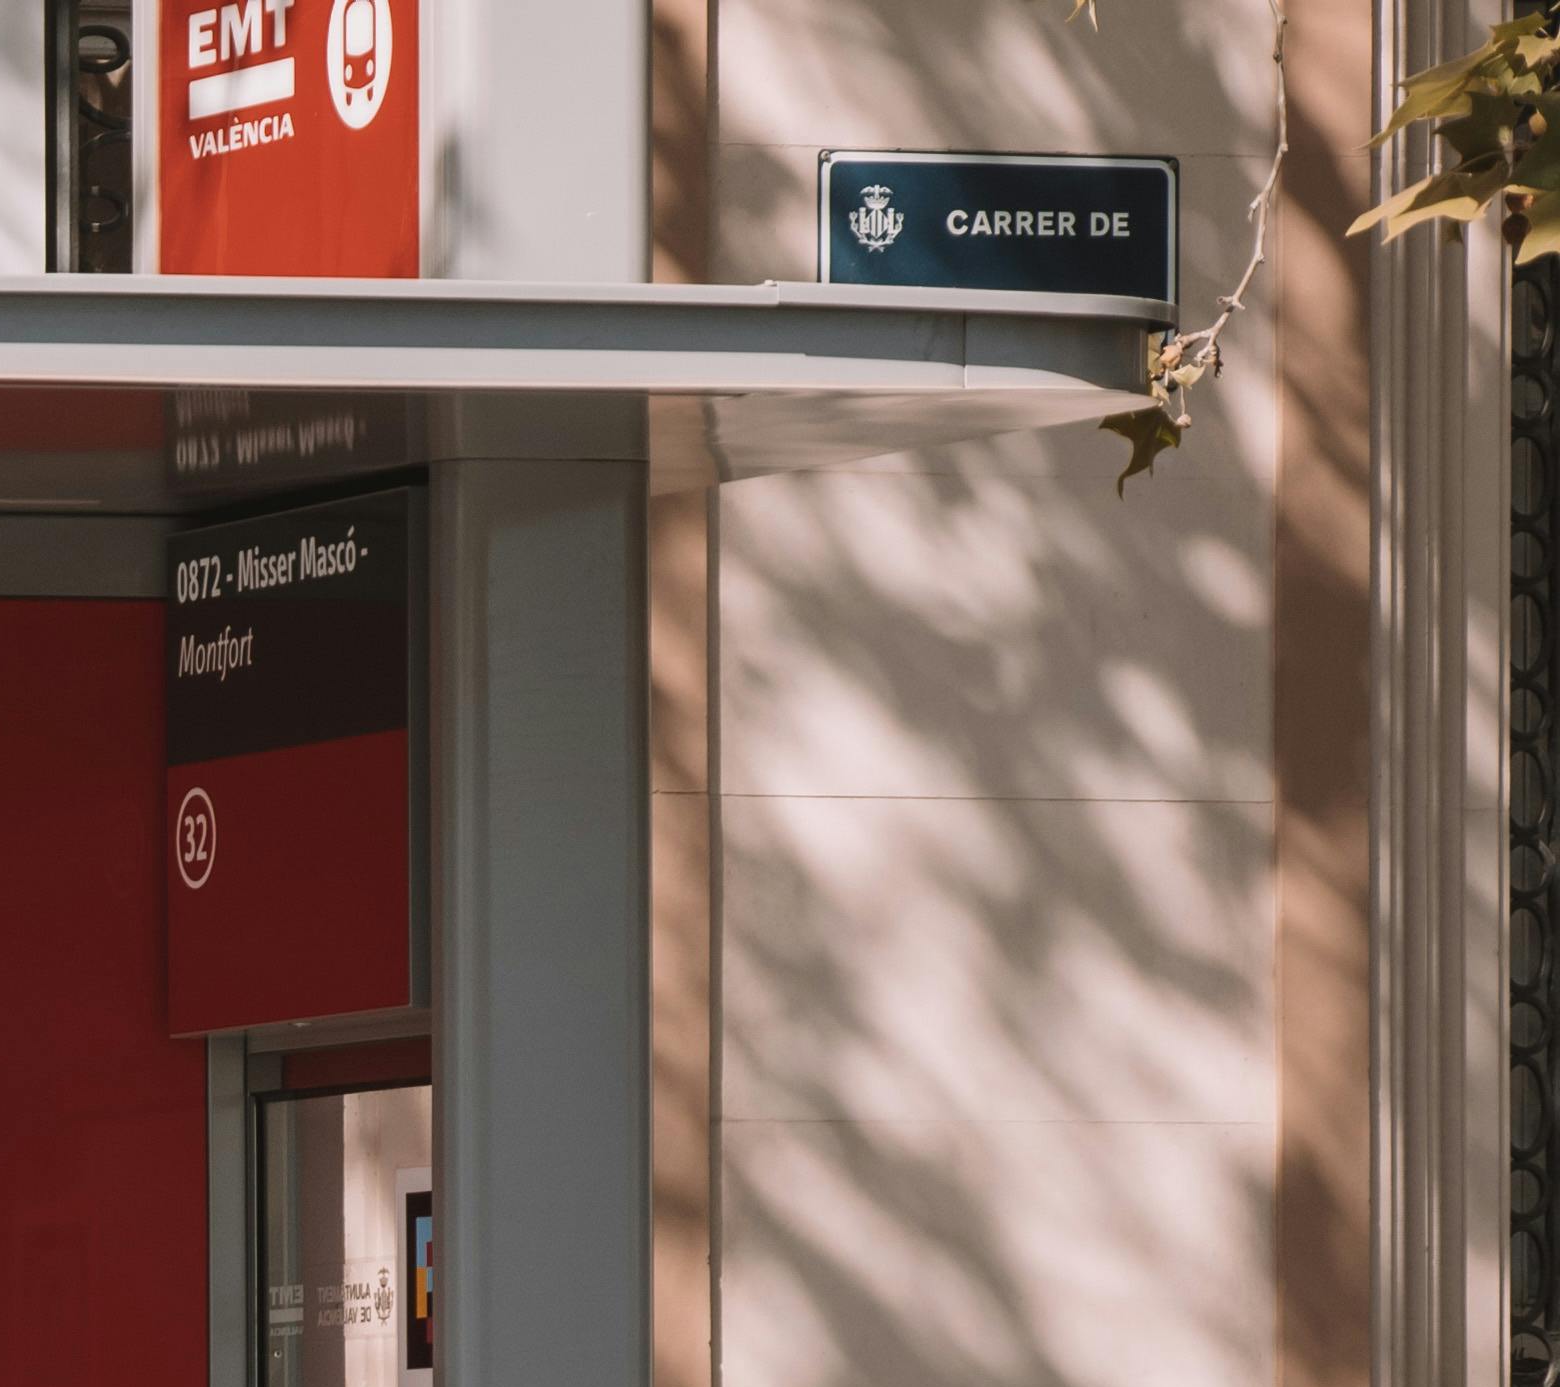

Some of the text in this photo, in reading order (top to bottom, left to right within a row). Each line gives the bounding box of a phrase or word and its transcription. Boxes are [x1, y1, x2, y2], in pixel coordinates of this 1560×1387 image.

[189, 0, 295, 69] EMT
[189, 112, 295, 160] VALÈNCIA
[946, 207, 1131, 238] CARRER DE
[177, 554, 221, 603] 0872
[237, 545, 295, 593] Misser
[300, 525, 357, 581] Mascó
[178, 624, 254, 682] Montfort
[184, 813, 208, 863] 32
